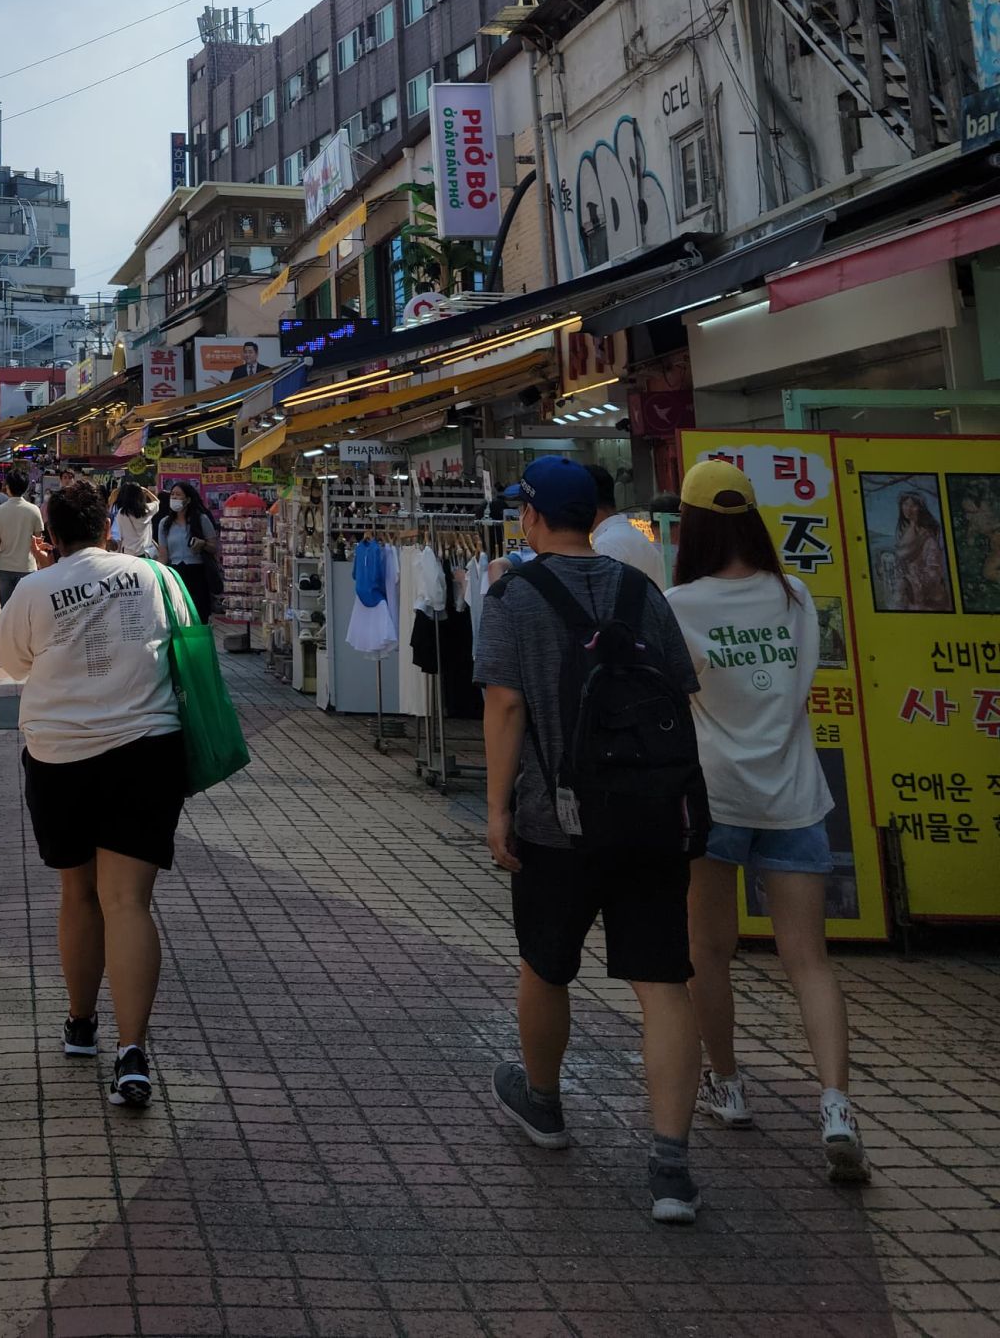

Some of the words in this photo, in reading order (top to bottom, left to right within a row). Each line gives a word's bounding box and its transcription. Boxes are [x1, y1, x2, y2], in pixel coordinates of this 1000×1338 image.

[462, 109, 494, 166] PHỞ
[966, 111, 999, 140] bar
[466, 171, 498, 209] BÒ
[347, 445, 405, 456] PHARMACY
[50, 582, 94, 612] ERIC
[98, 572, 141, 597] NAM
[708, 624, 773, 648] Have
[776, 624, 792, 641] a
[706, 645, 760, 670] Nice
[762, 642, 799, 670] Day
[807, 686, 855, 715] 로점
[815, 723, 841, 743] 손금
[892, 772, 973, 803] 연애운
[897, 813, 980, 844] 재물운
